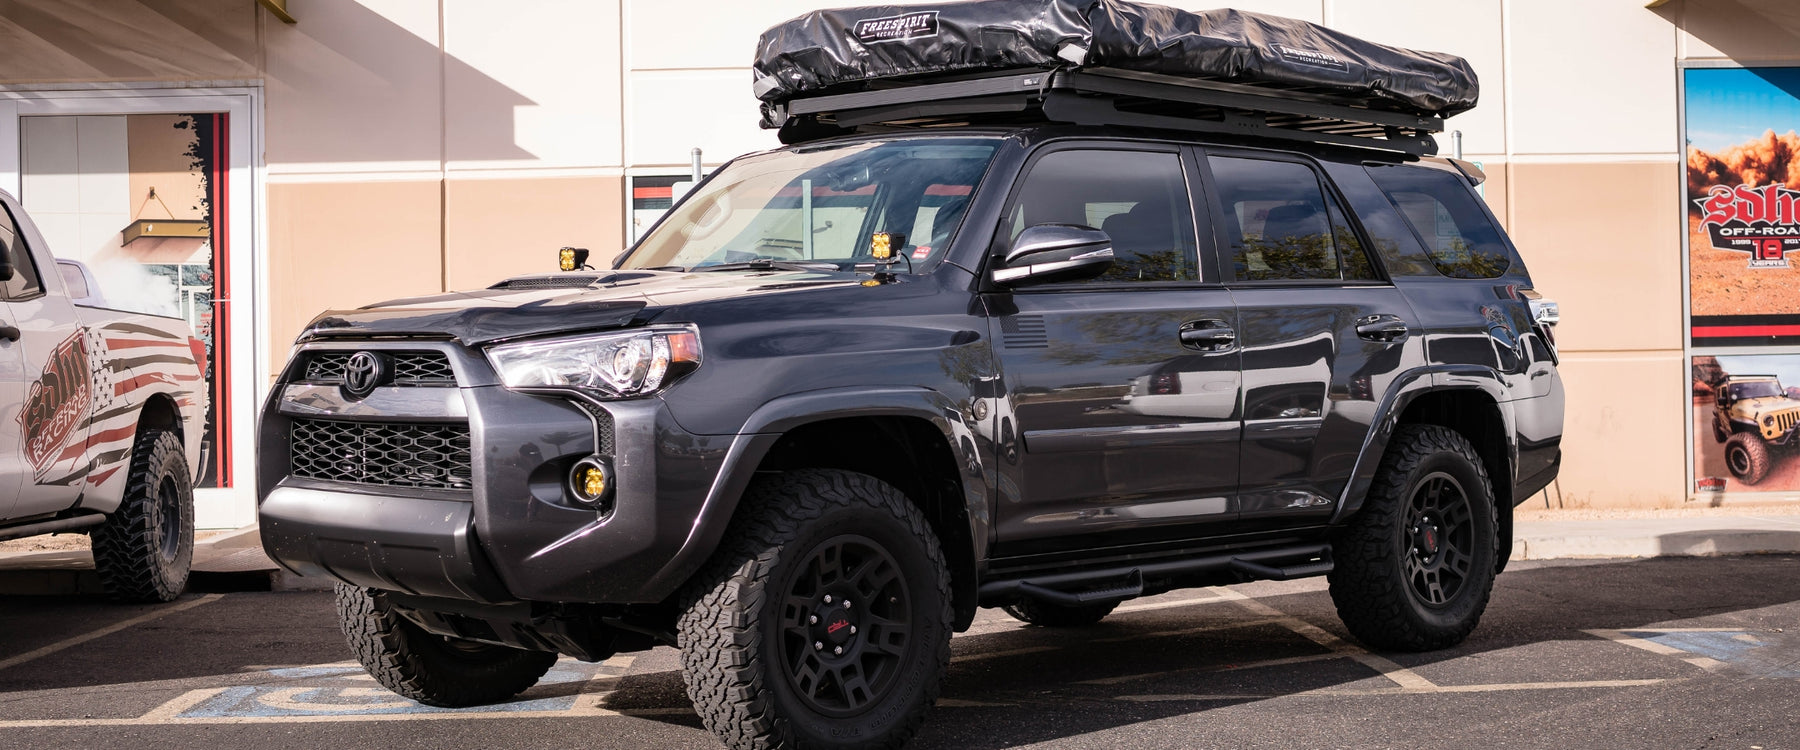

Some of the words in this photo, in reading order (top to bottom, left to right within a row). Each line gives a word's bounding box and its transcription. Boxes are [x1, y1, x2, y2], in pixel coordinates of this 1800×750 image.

[860, 14, 931, 35] FREESPIRIT
[876, 29, 912, 37] RECREATION
[1299, 56, 1328, 65] RECREATION
[1720, 227, 1800, 236] OFF-ROA
[1752, 239, 1782, 259] 18
[33, 396, 87, 462] RACING
